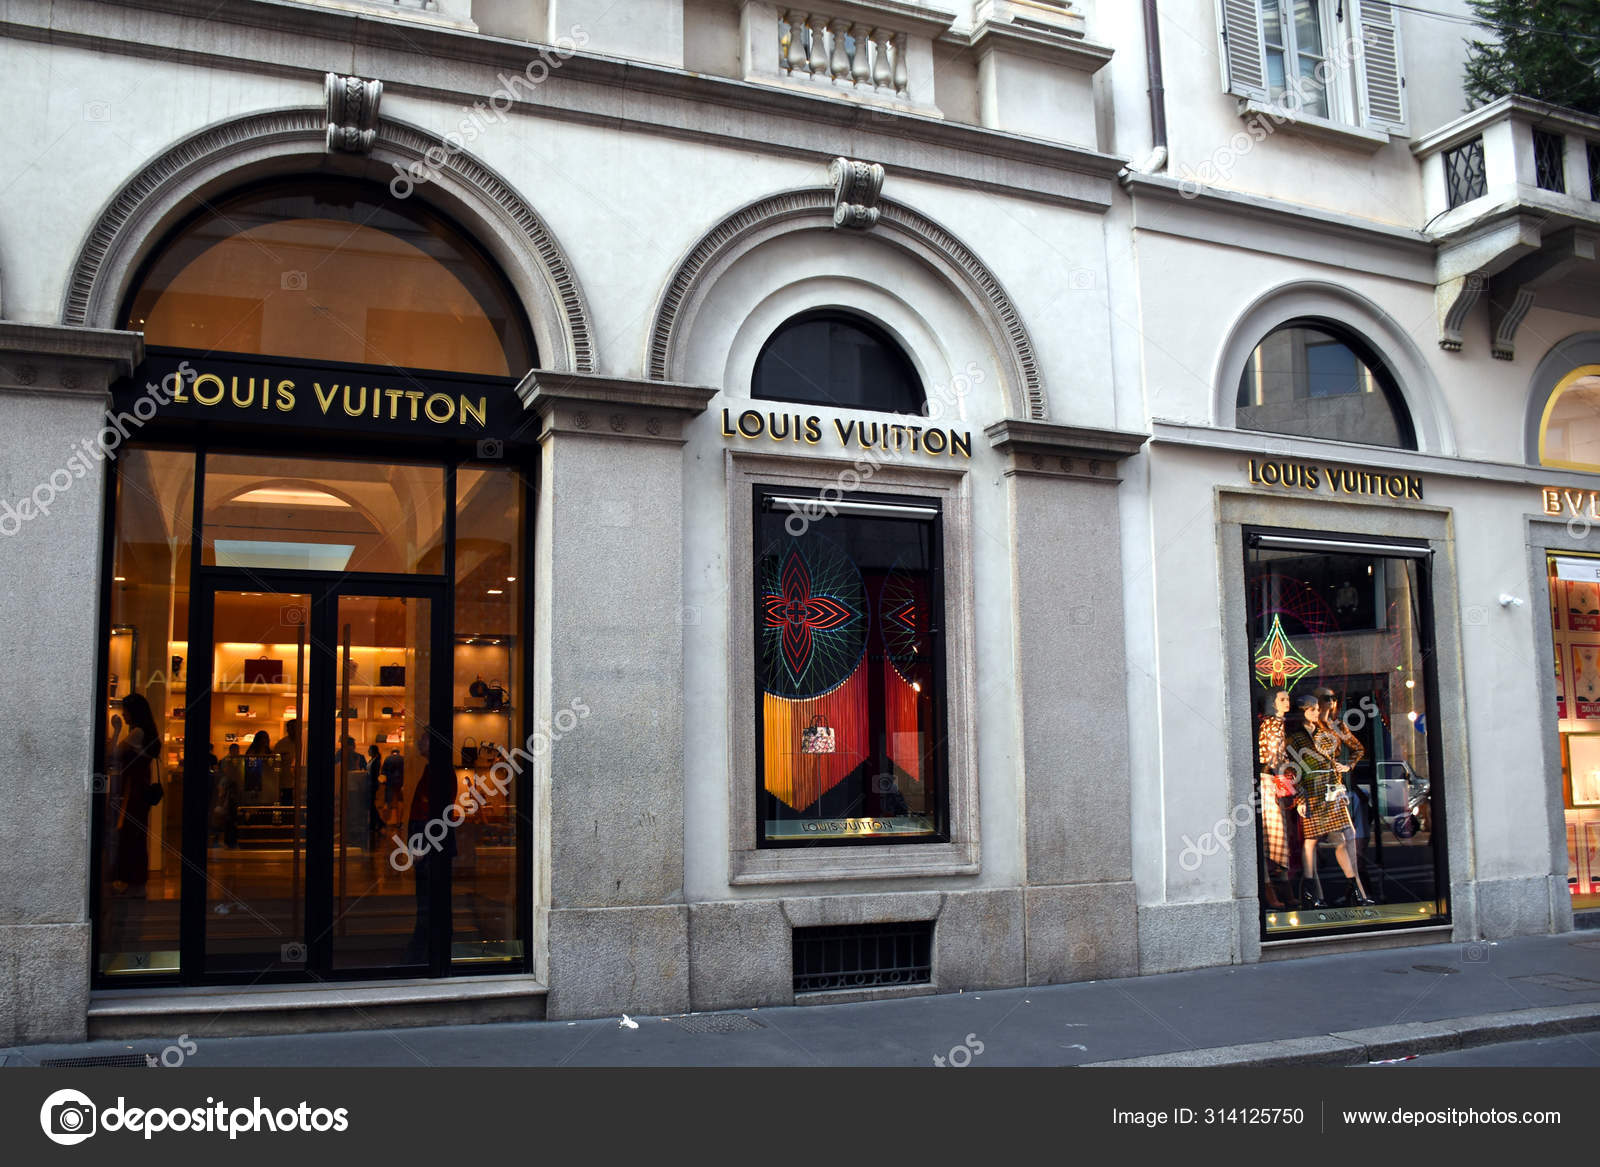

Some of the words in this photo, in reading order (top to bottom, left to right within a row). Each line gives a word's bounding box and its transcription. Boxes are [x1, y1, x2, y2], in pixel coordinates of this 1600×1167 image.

[174, 372, 296, 411] LOUIS
[314, 382, 486, 427] VUITTON
[721, 408, 822, 445] LOUIS
[833, 418, 972, 459] VUITTON
[1248, 459, 1320, 490] LOUIS
[1325, 467, 1424, 499] VUITTON
[801, 821, 838, 832] LOUIS
[840, 820, 894, 832] VUITTON
